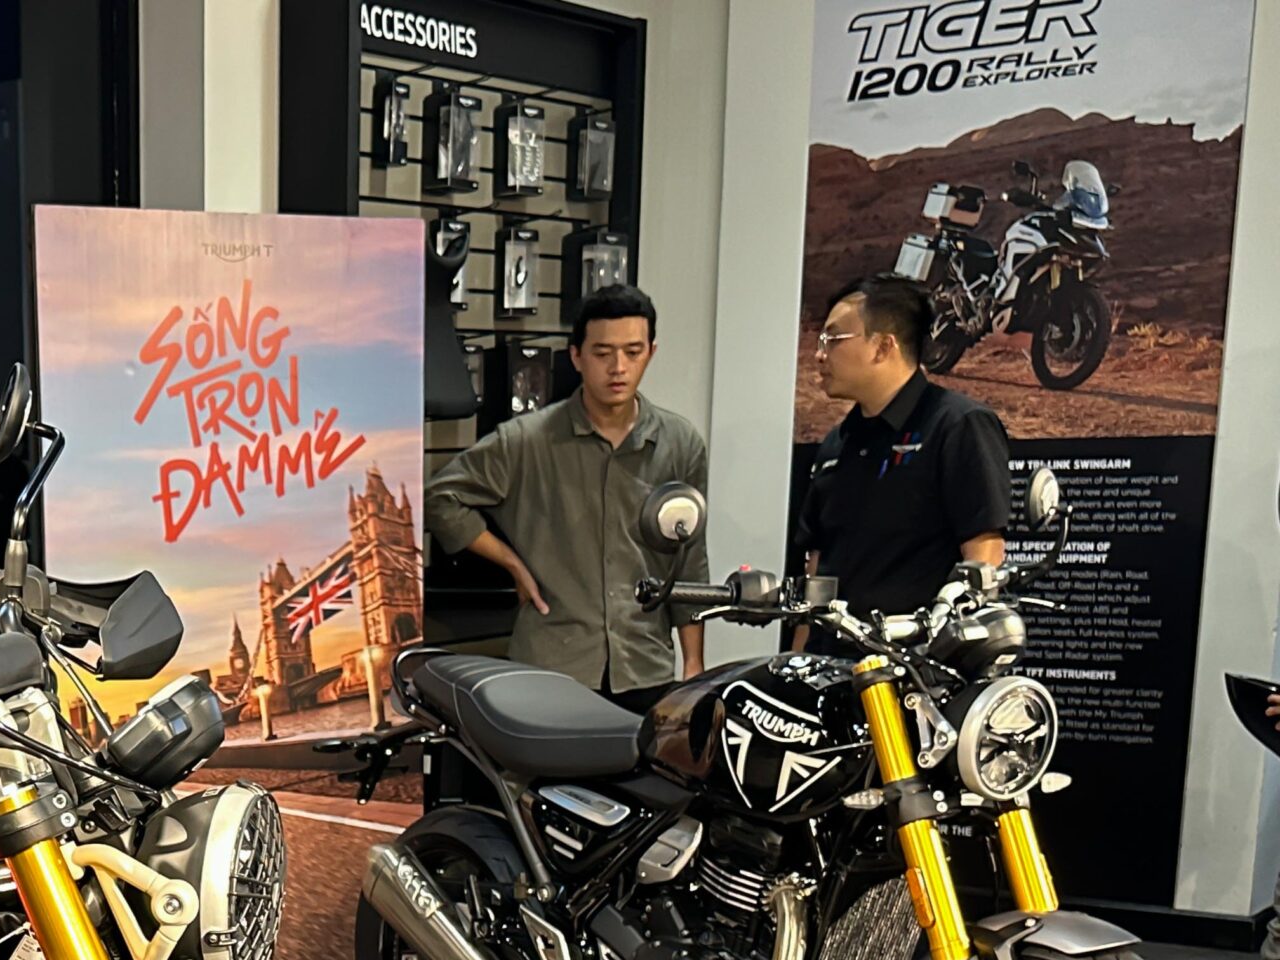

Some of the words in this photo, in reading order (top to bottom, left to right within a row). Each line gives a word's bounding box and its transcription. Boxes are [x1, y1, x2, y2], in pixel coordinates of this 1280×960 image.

[361, 3, 477, 58] ACCESSORIES
[848, 0, 1102, 64] TIGER
[967, 44, 1098, 73] RALLY
[847, 59, 962, 102] 1200
[962, 61, 1098, 89] EXPLORER
[201, 243, 260, 263] TRIUMPH
[1008, 459, 1026, 470] EW
[1073, 458, 1131, 470] SWINGARM
[1096, 541, 1111, 551] OF
[1046, 668, 1116, 681] INSTRUMENTS
[741, 700, 820, 746] TRIUMPH
[951, 824, 973, 837] THE
